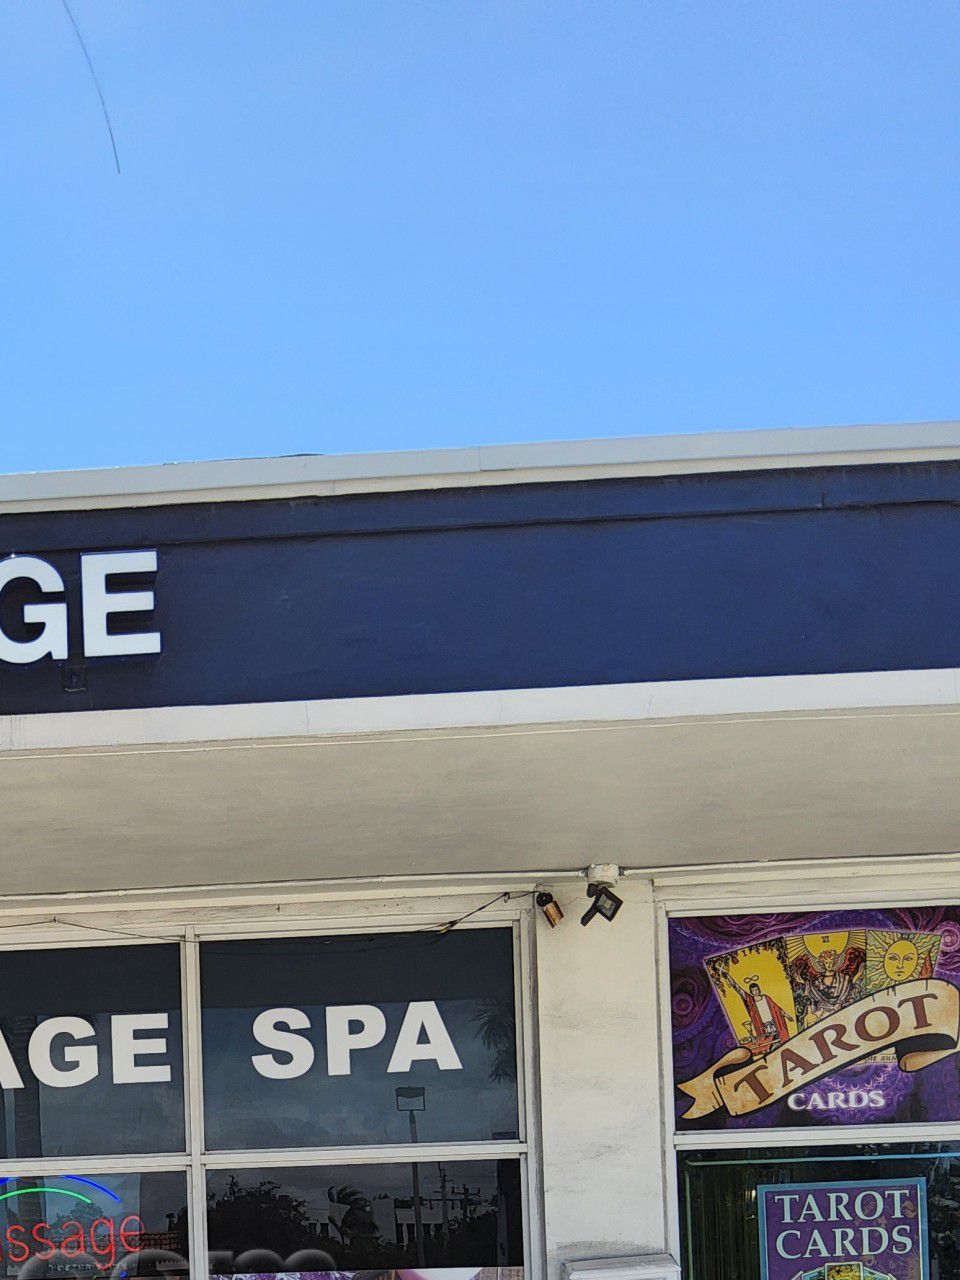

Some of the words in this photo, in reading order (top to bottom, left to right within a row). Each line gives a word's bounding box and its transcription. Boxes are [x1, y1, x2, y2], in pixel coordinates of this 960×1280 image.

[251, 1000, 463, 1079] SPA
[734, 993, 939, 1105] TAROT
[788, 1090, 885, 1110] CARDS
[774, 1189, 909, 1223] TAROT
[776, 1225, 913, 1259] CARDS
